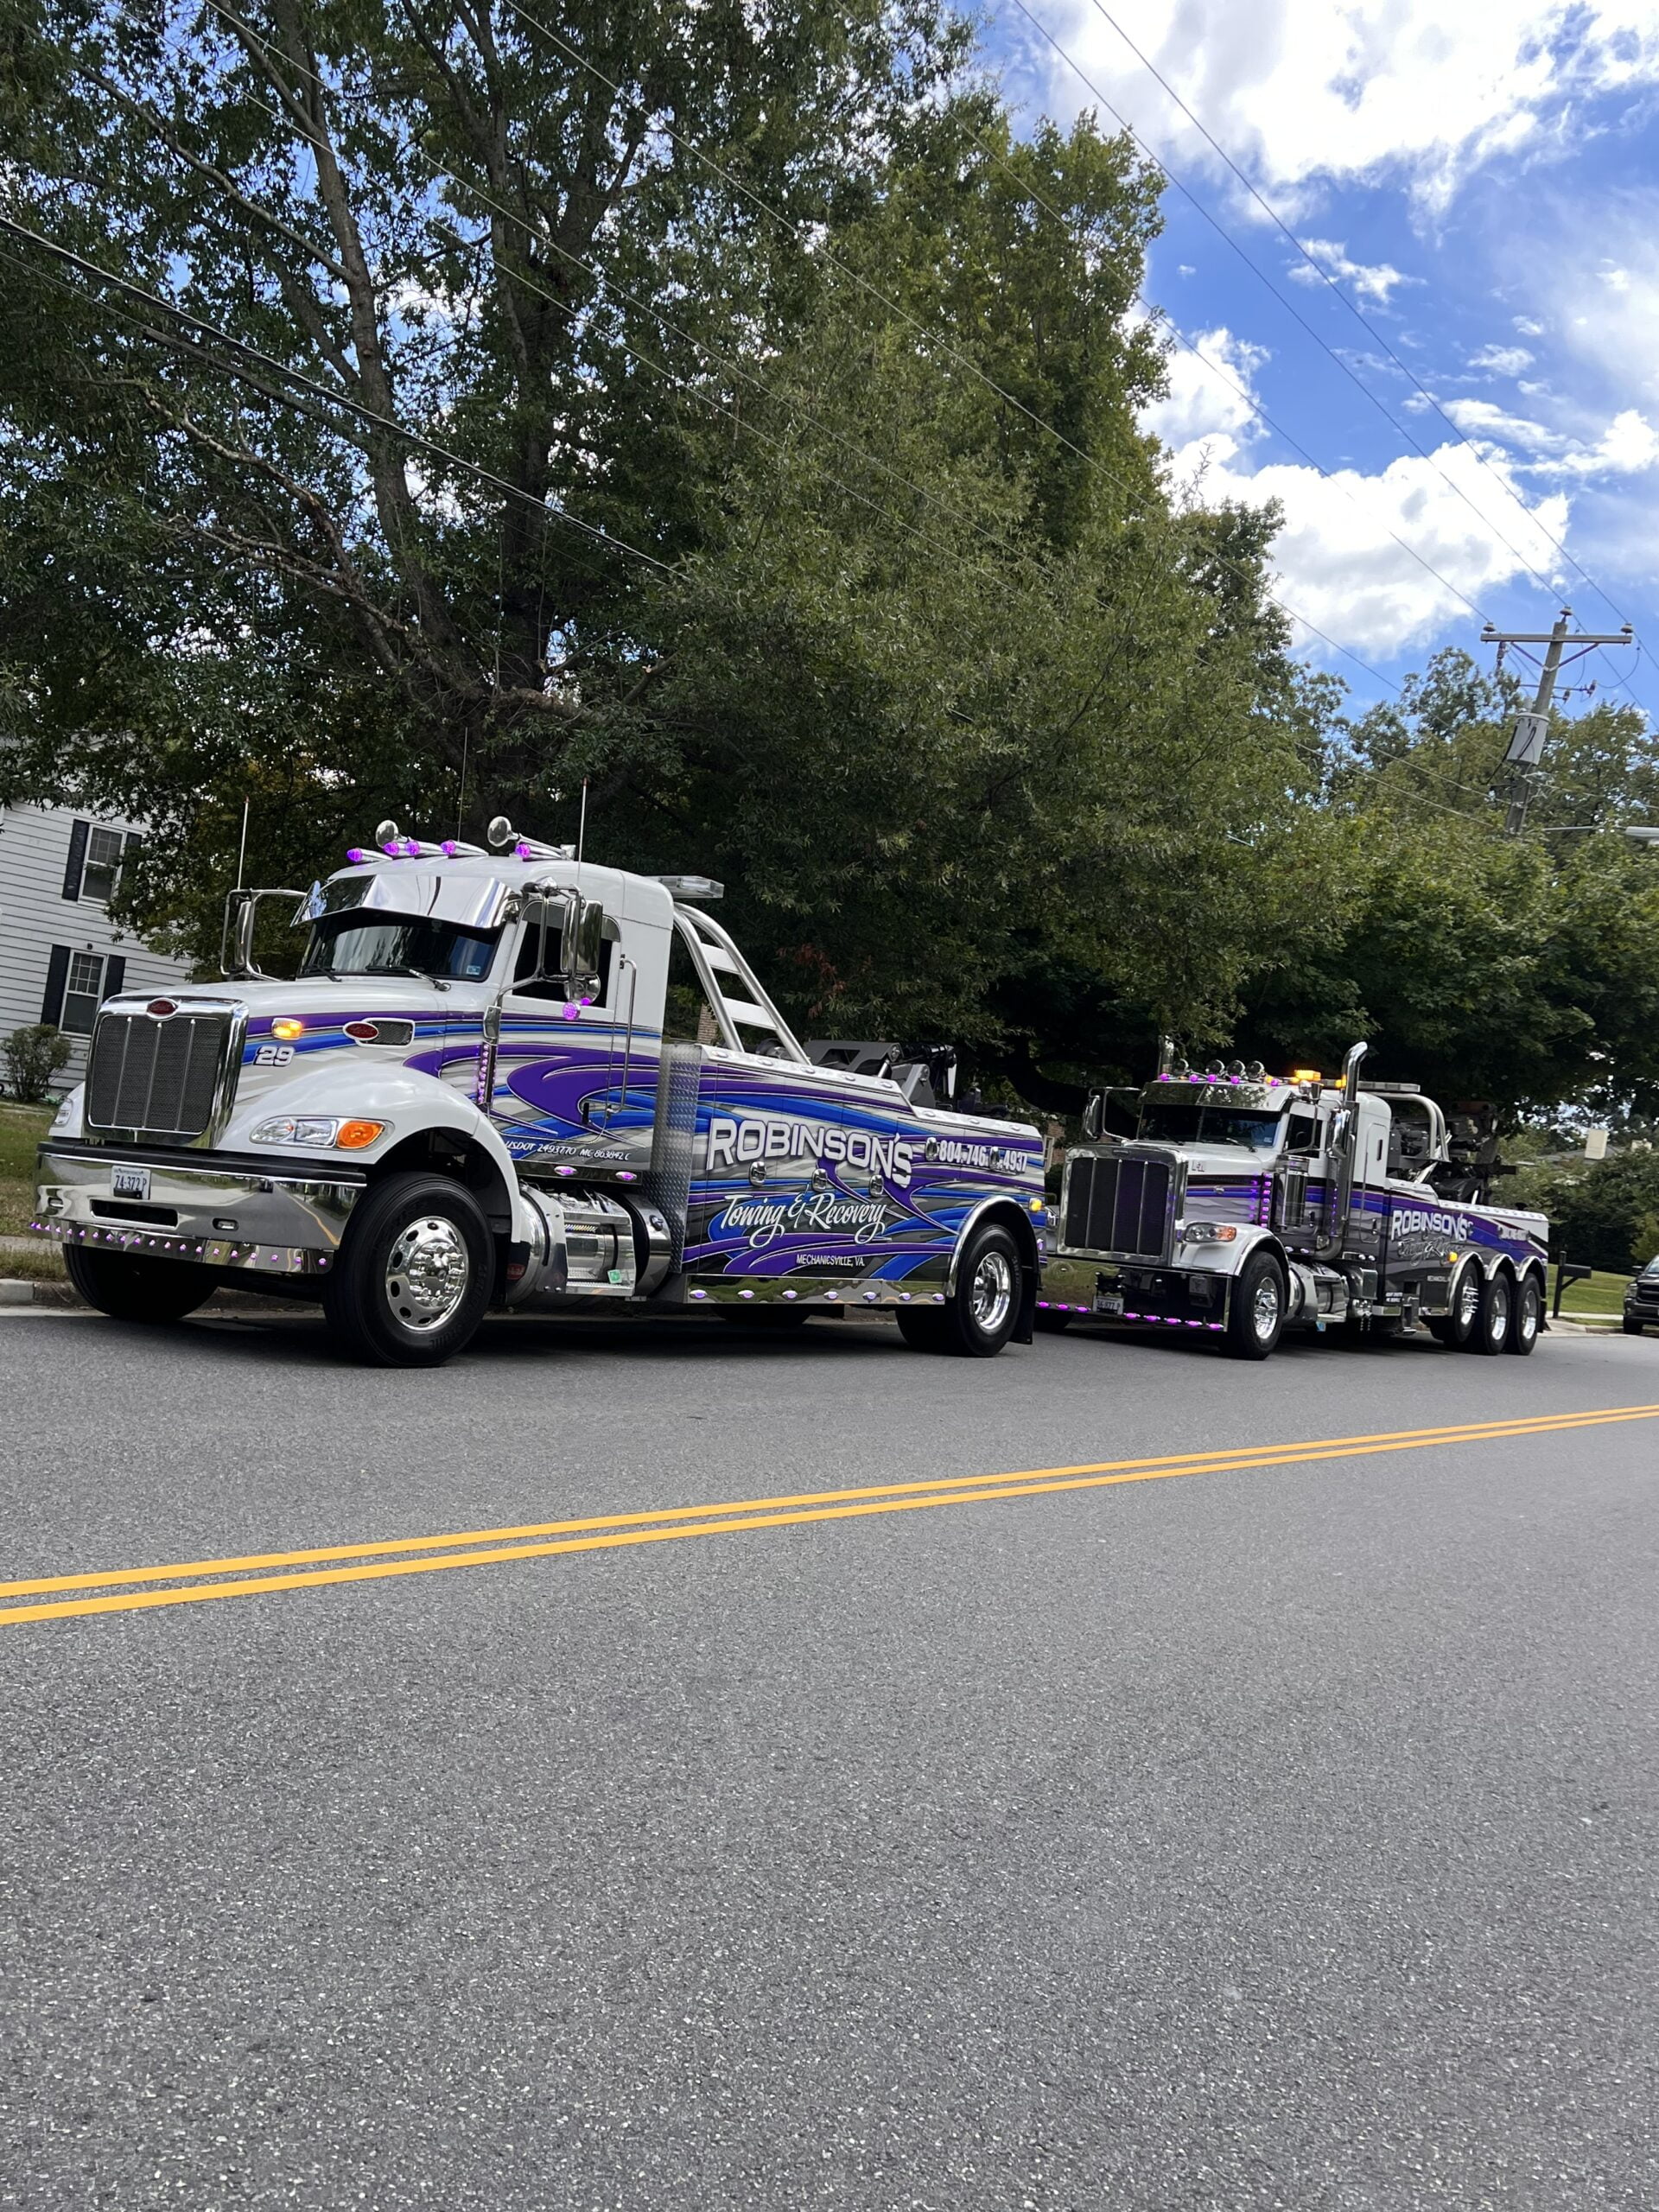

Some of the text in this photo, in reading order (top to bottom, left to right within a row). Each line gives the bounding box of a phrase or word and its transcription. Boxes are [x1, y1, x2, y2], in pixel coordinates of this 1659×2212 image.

[254, 1046, 295, 1066] 29
[505, 1140, 537, 1151] USDOT
[537, 1143, 577, 1155] 2493770
[579, 1148, 594, 1157] MC
[705, 1117, 913, 1188] ROBINSON'S
[720, 1193, 786, 1249] Towing
[804, 1192, 888, 1245] Recovery
[1390, 1210, 1469, 1242] ROBINSON'S
